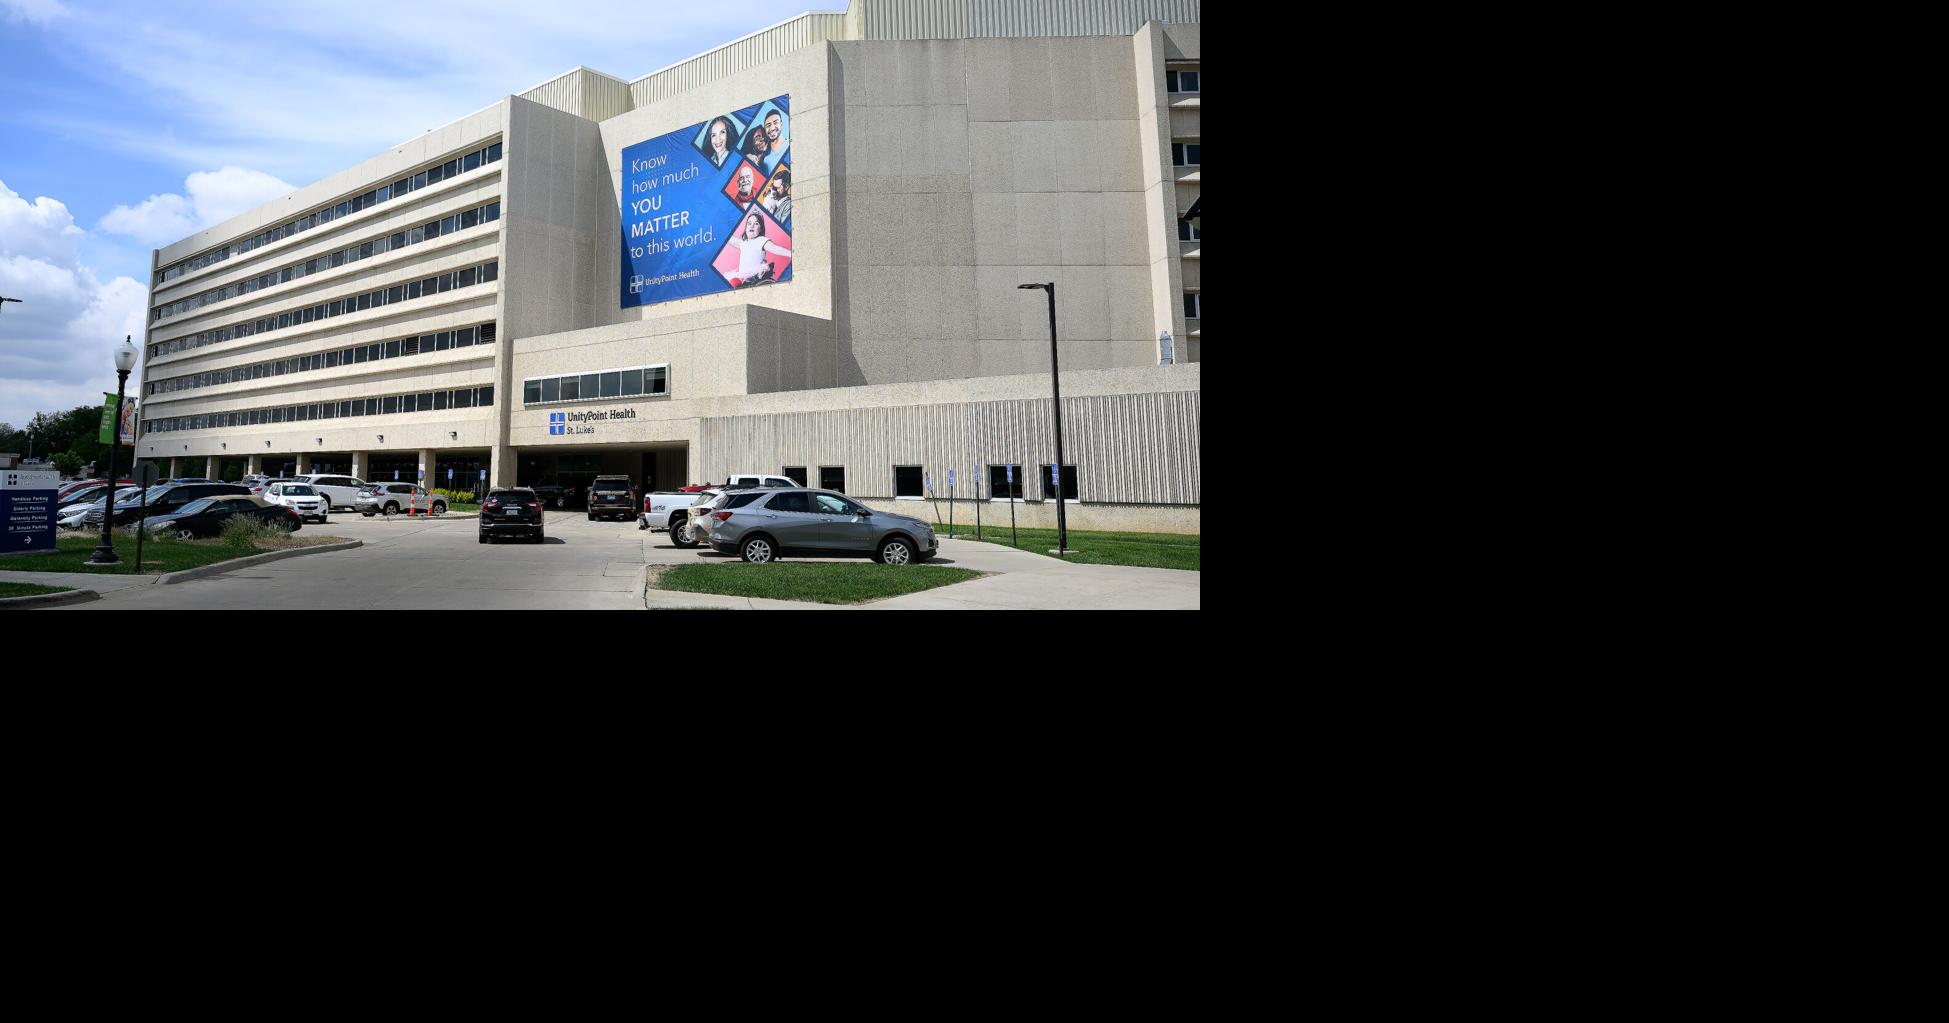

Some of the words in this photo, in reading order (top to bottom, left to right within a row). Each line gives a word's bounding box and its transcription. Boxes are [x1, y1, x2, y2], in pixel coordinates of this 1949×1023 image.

[632, 153, 667, 174] Know
[632, 177, 658, 194] how
[662, 163, 699, 186] much
[631, 195, 662, 215] YOU
[631, 211, 690, 238] MATTER
[630, 244, 644, 259] to
[647, 238, 670, 256] this
[674, 224, 717, 249] world.
[645, 274, 677, 286] UnityPoint
[678, 268, 700, 280] Health
[567, 411, 608, 423] UnityPoint
[610, 408, 636, 420] Health
[566, 426, 575, 435] St.
[576, 425, 595, 434] Luke's
